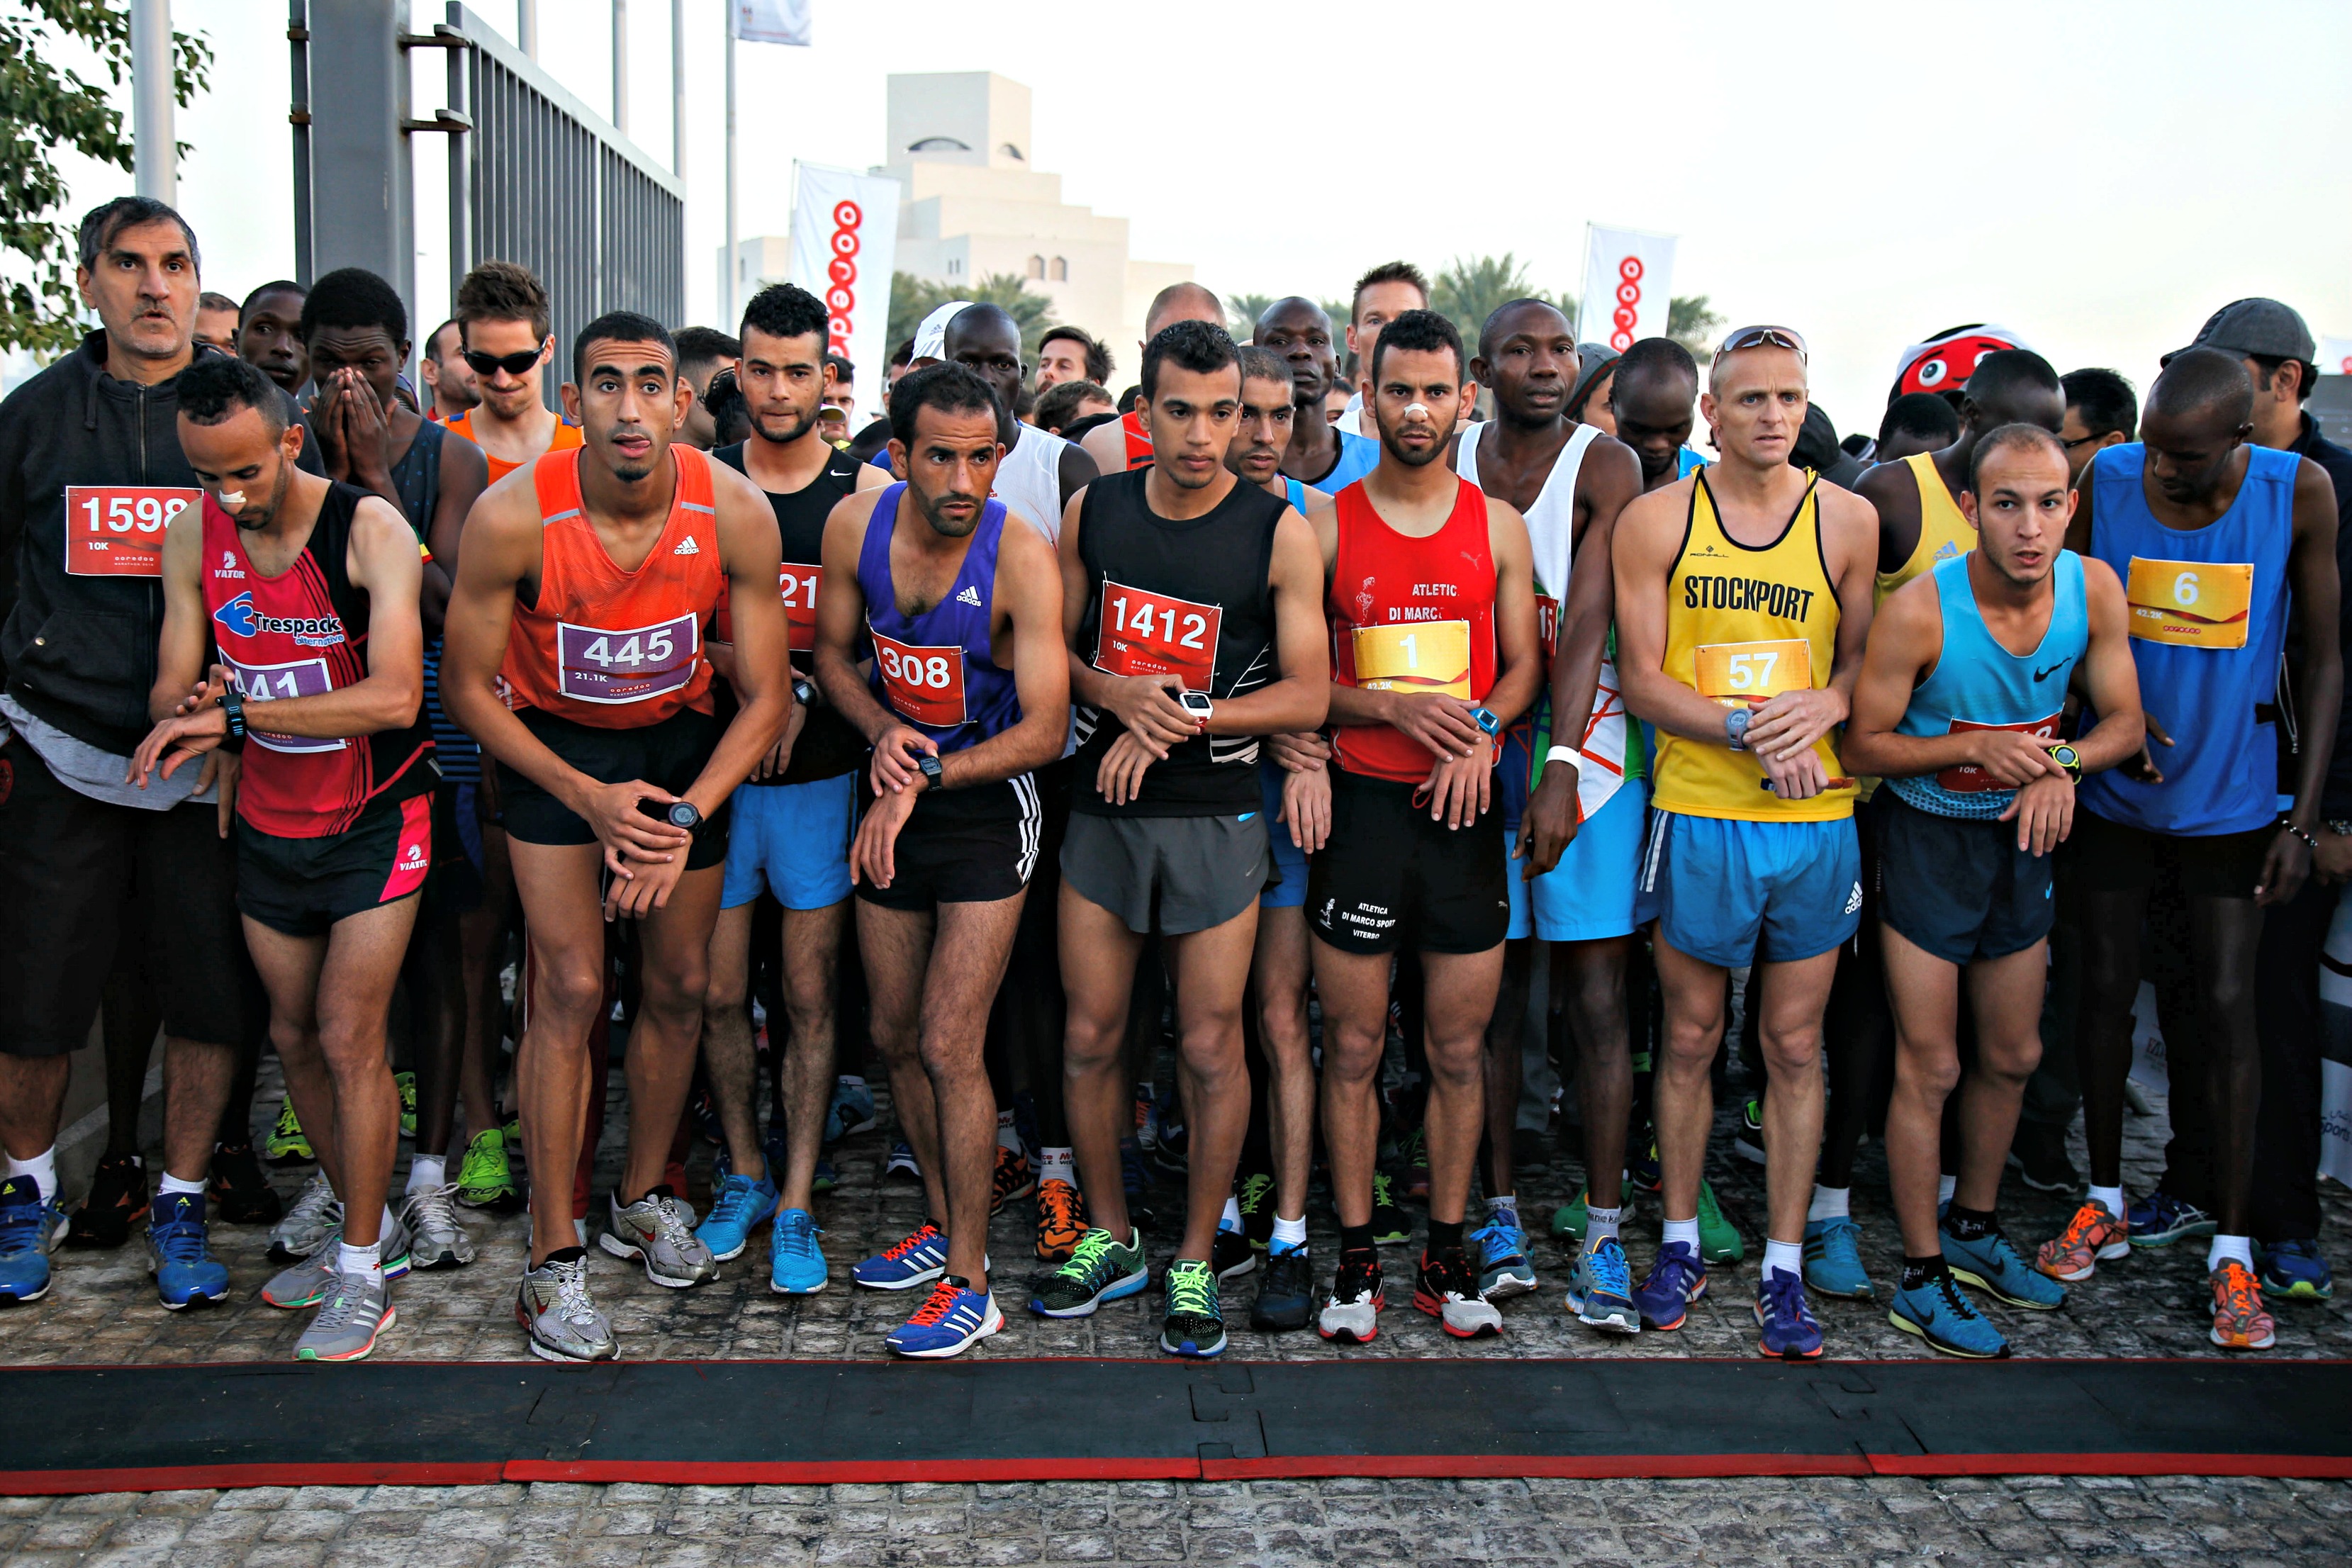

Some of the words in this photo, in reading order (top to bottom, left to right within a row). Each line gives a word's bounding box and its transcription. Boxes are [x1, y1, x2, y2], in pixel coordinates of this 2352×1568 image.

[88, 542, 109, 551] 10K
[2174, 572, 2199, 605] 6
[956, 594, 982, 607] adidas
[1684, 575, 1815, 623] STOCKPORT
[1389, 607, 1401, 621] DI
[1404, 607, 1443, 620] MARC
[2136, 608, 2163, 620] 42.2K
[254, 613, 343, 637] Trespack
[1113, 596, 1206, 650] 1412
[2163, 625, 2201, 634] ooredoo
[583, 628, 673, 668] 445
[1112, 640, 1129, 653] 10K
[1399, 634, 1418, 668] 1
[1131, 659, 1167, 671] ooredoo
[1729, 652, 1779, 689] 57
[575, 672, 607, 683] 21.1K
[610, 683, 651, 693] ooredoo
[1367, 681, 1393, 690] 42.2K
[1357, 902, 1388, 914] ATLETICA
[1341, 912, 1350, 921] DI
[1350, 914, 1375, 926] MARCO
[1376, 919, 1396, 928] SPORT
[1353, 929, 1380, 939] VITERBO
